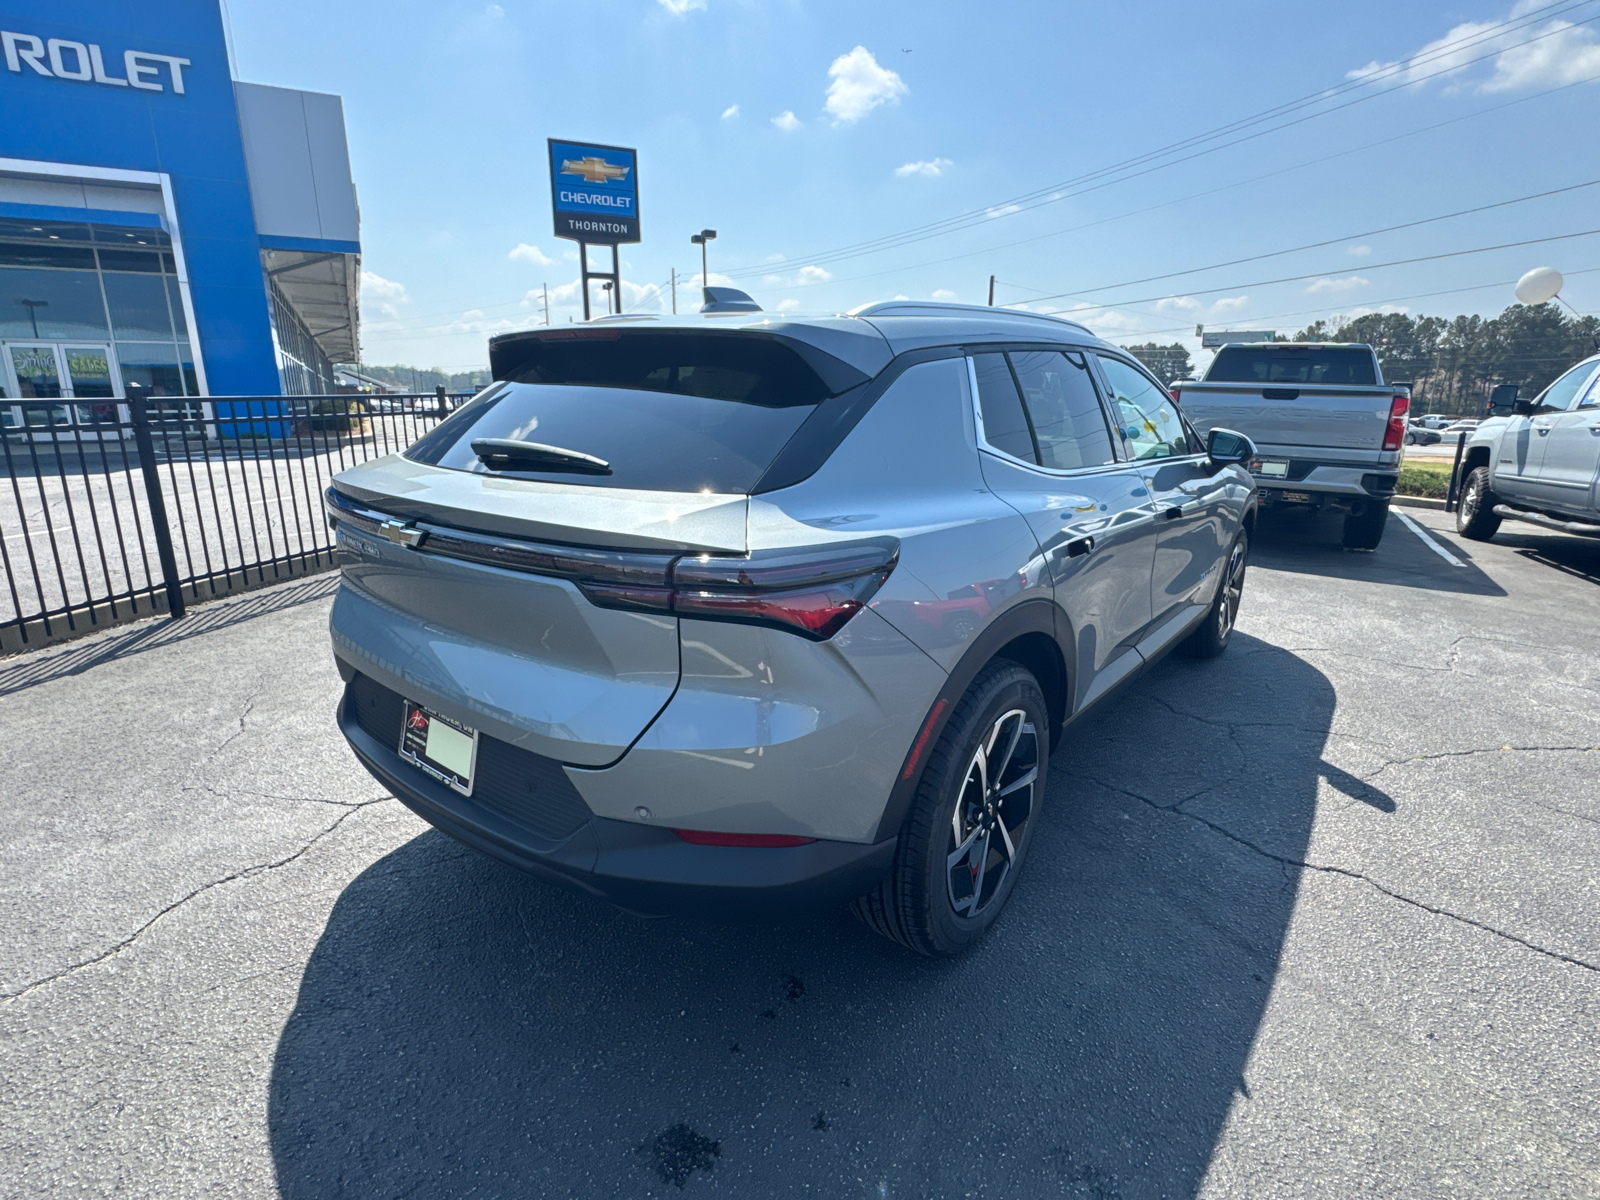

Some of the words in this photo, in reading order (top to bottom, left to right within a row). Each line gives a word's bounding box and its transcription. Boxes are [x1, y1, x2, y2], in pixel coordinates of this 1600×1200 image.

[1, 31, 191, 94] ROLET
[560, 191, 631, 208] CHEVROLET
[568, 220, 628, 233] THORNTON
